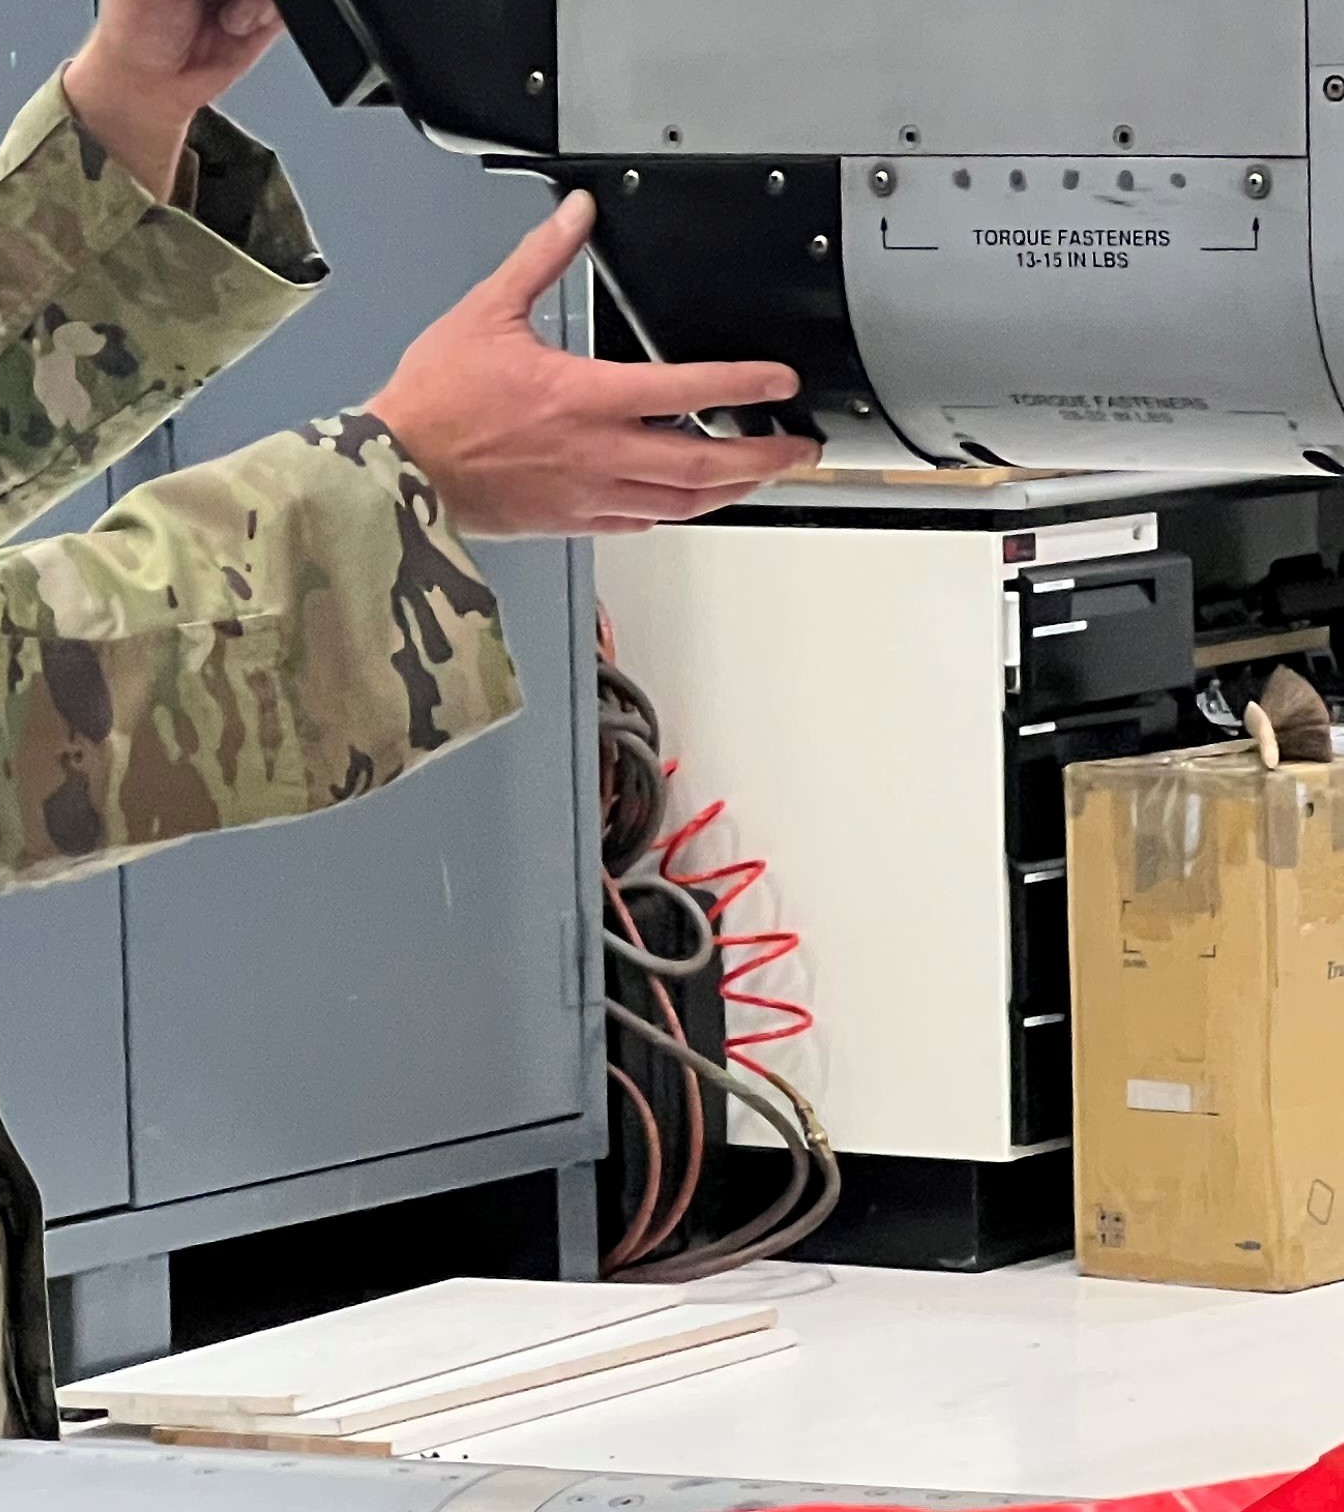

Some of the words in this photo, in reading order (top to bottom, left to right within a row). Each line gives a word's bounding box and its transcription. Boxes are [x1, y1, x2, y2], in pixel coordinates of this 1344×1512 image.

[972, 228, 1052, 247] TORQUE
[1057, 228, 1171, 248] FASTENERS
[1016, 251, 1063, 269] 13-15
[1067, 251, 1087, 269] IN
[1092, 251, 1129, 269] LBS
